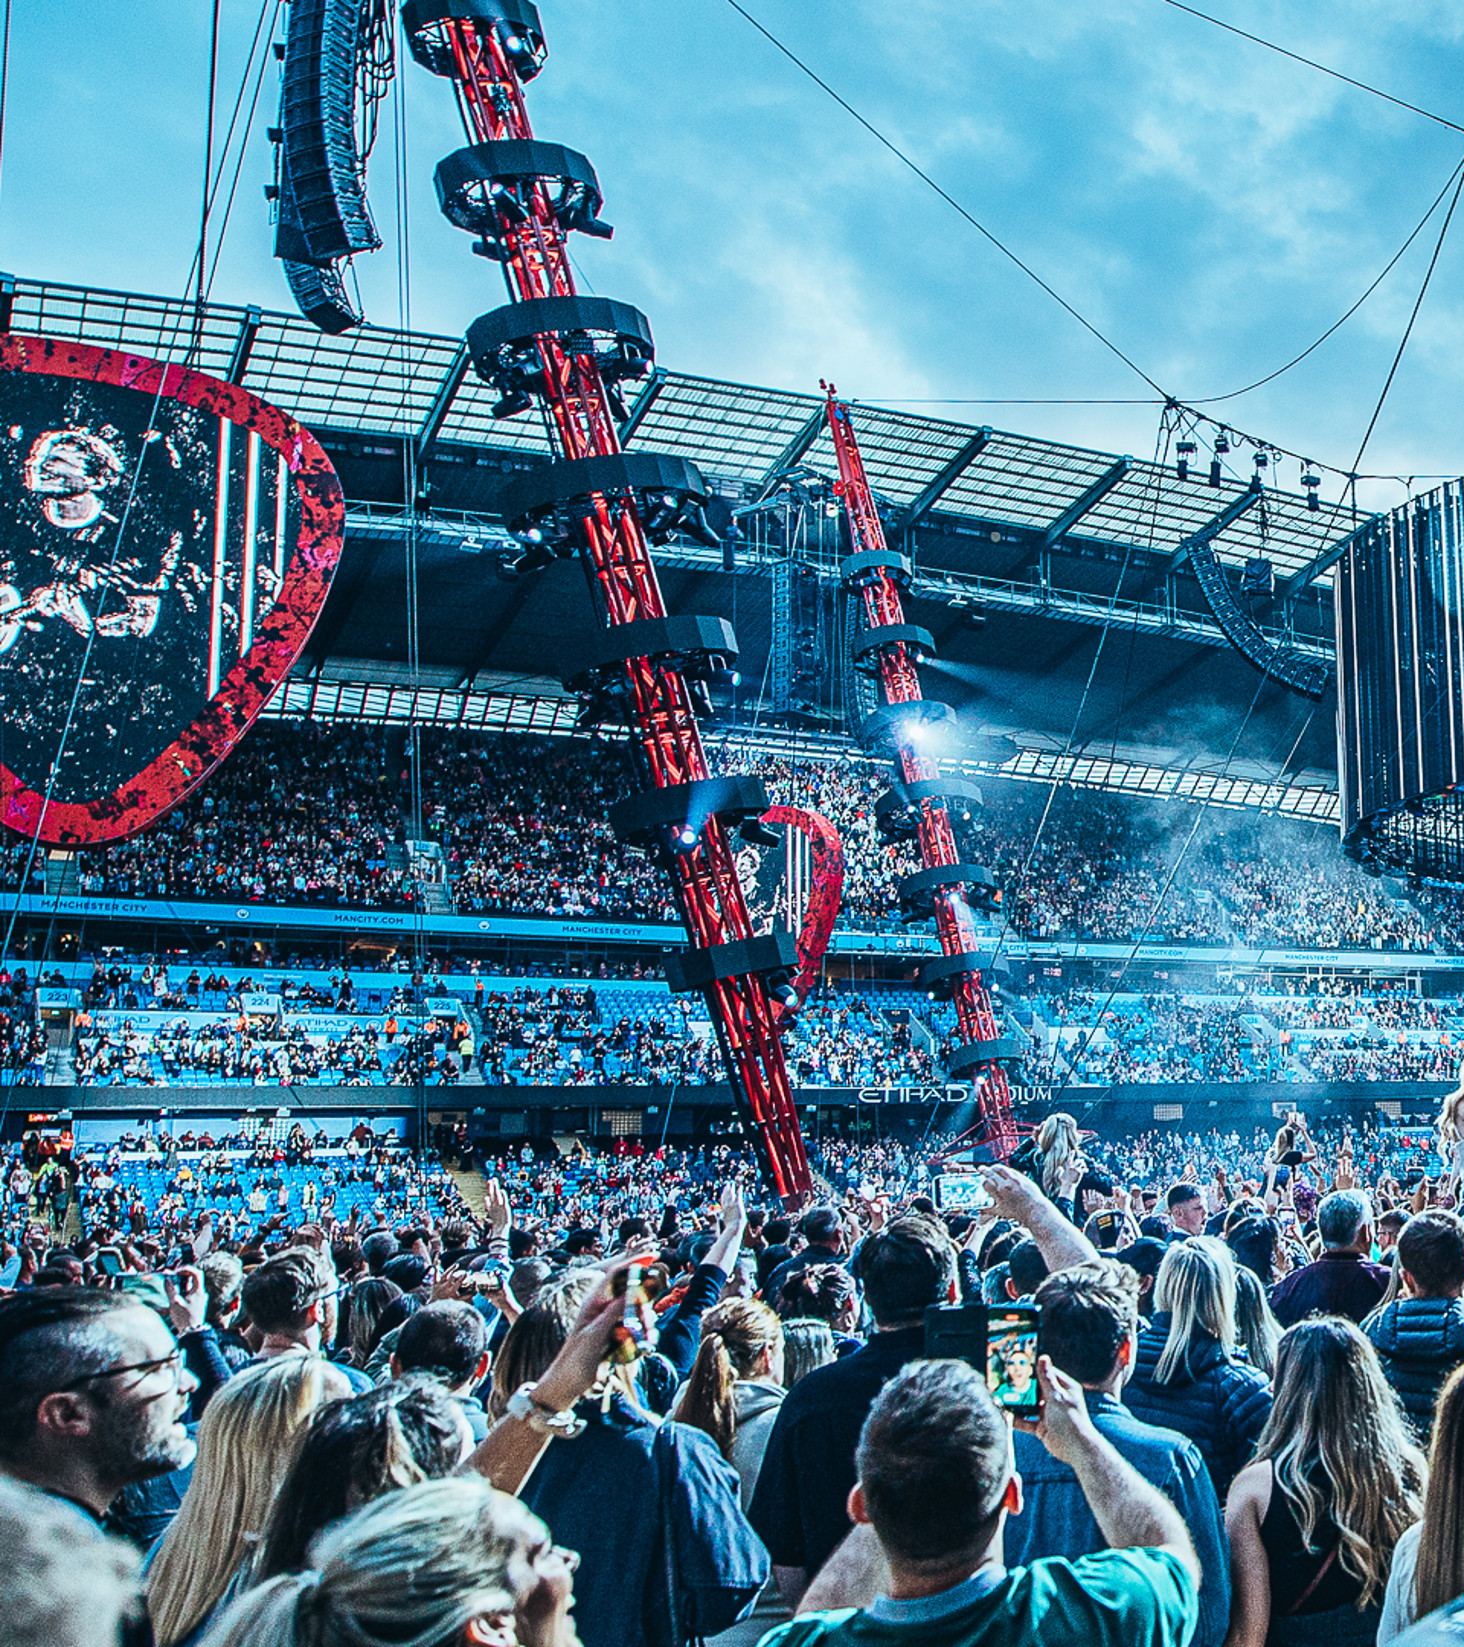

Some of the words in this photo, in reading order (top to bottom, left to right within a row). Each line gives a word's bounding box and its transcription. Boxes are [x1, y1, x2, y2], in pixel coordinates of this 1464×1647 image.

[41, 899, 119, 911] MANCHESTER
[121, 903, 147, 912] CITY
[334, 914, 404, 925] MANCITY.COM
[562, 925, 620, 935] MANCHESTER
[622, 928, 642, 936] CITY
[858, 1086, 968, 1103] ETIHAD
